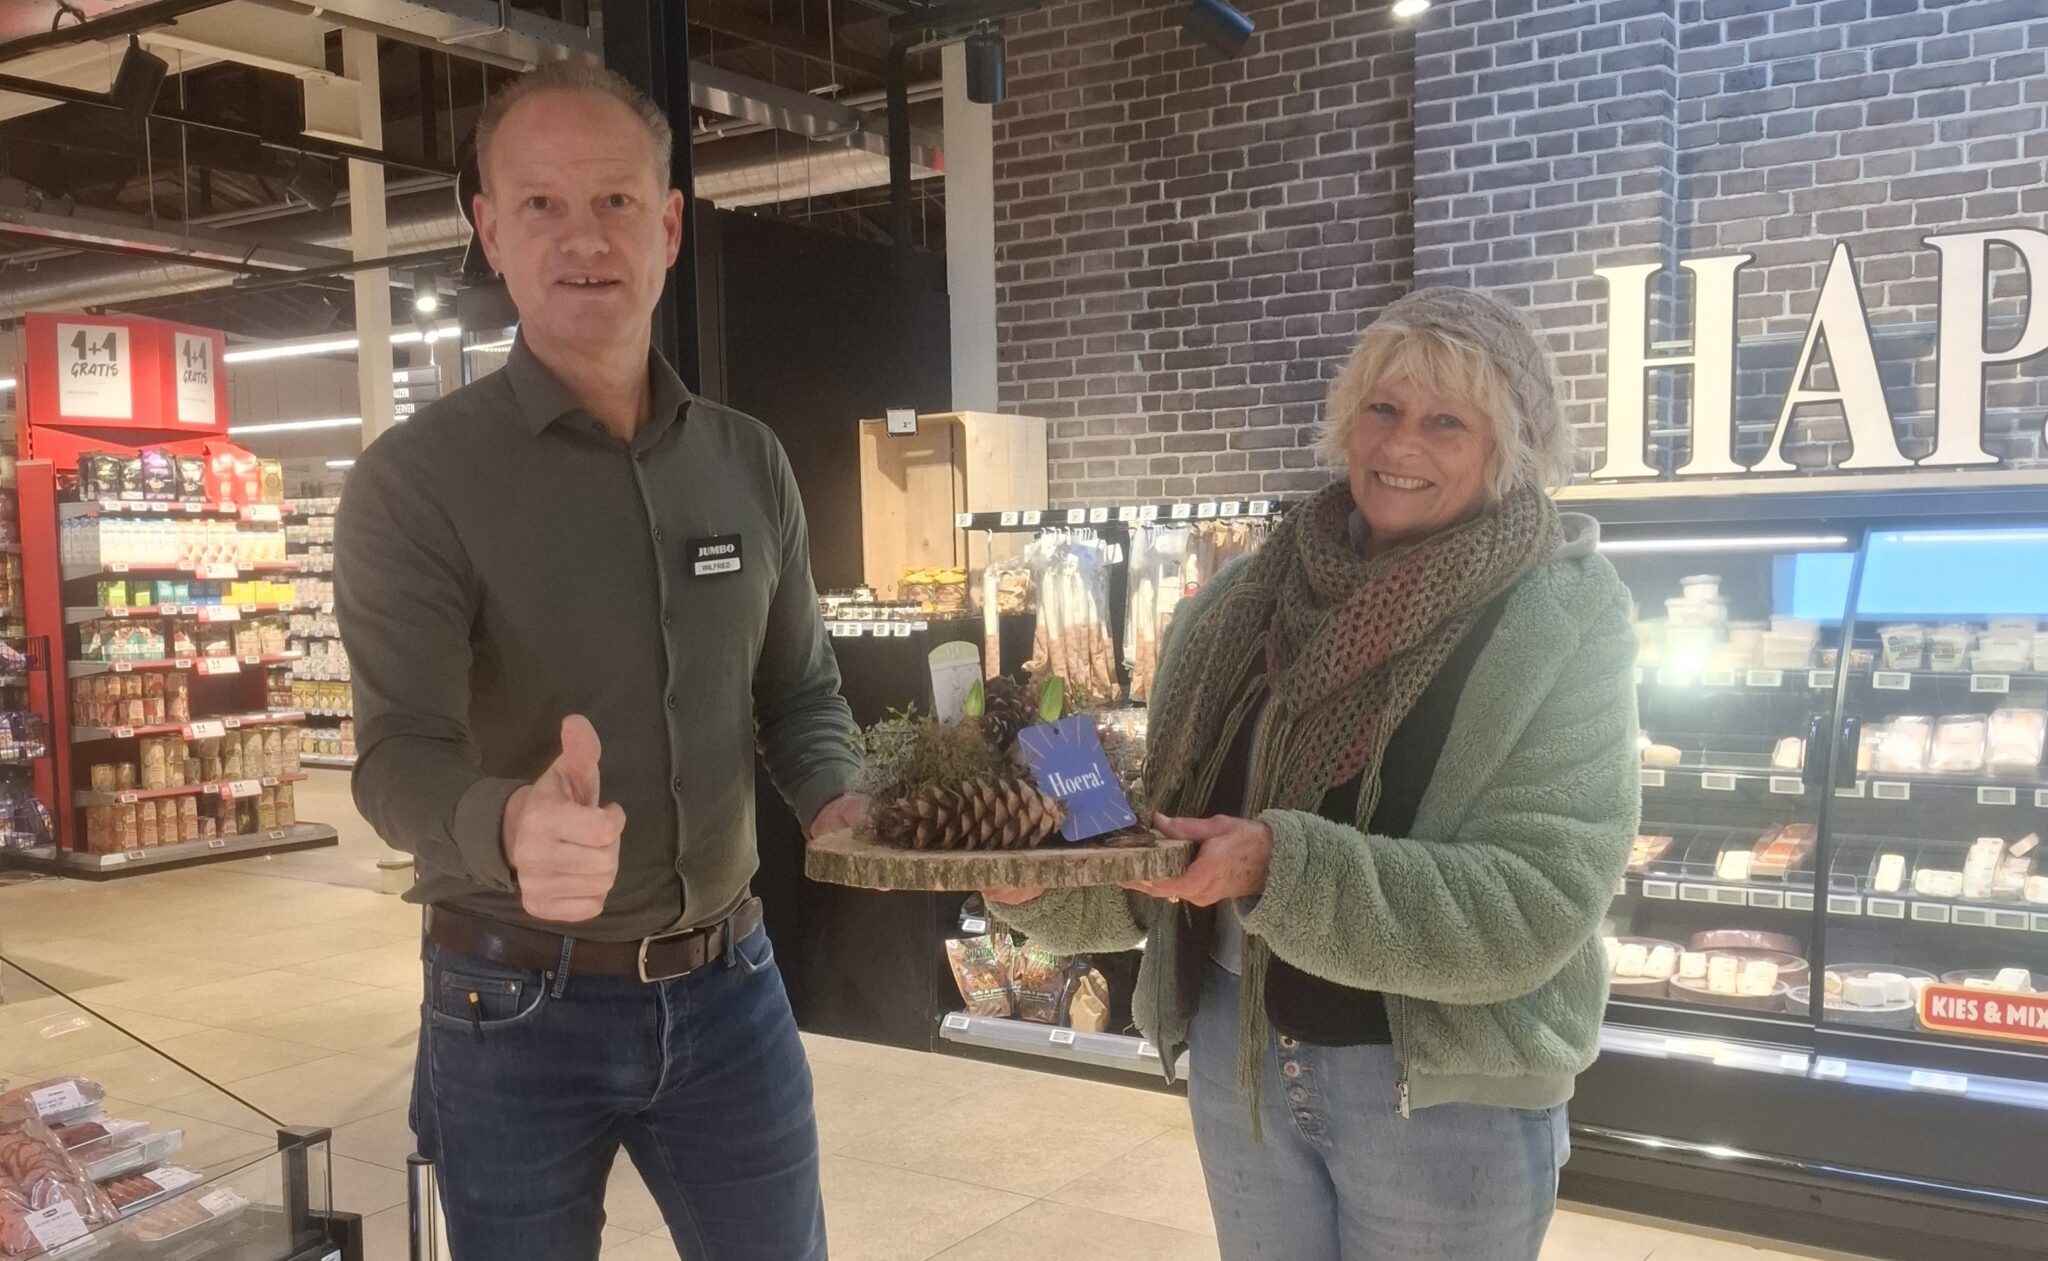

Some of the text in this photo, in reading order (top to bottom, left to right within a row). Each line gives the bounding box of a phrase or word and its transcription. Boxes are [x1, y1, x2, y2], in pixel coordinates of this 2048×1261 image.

[70, 330, 117, 361] 1+1
[182, 339, 207, 370] 1+1
[1590, 228, 2048, 479] HAP
[70, 362, 119, 378] GRATIS
[183, 369, 208, 385] GRATIS
[697, 543, 736, 557] JUMBO
[701, 561, 731, 571] WILFRED
[1048, 762, 1105, 797] Hoera!
[1931, 995, 2048, 1029] KIES & MIX
